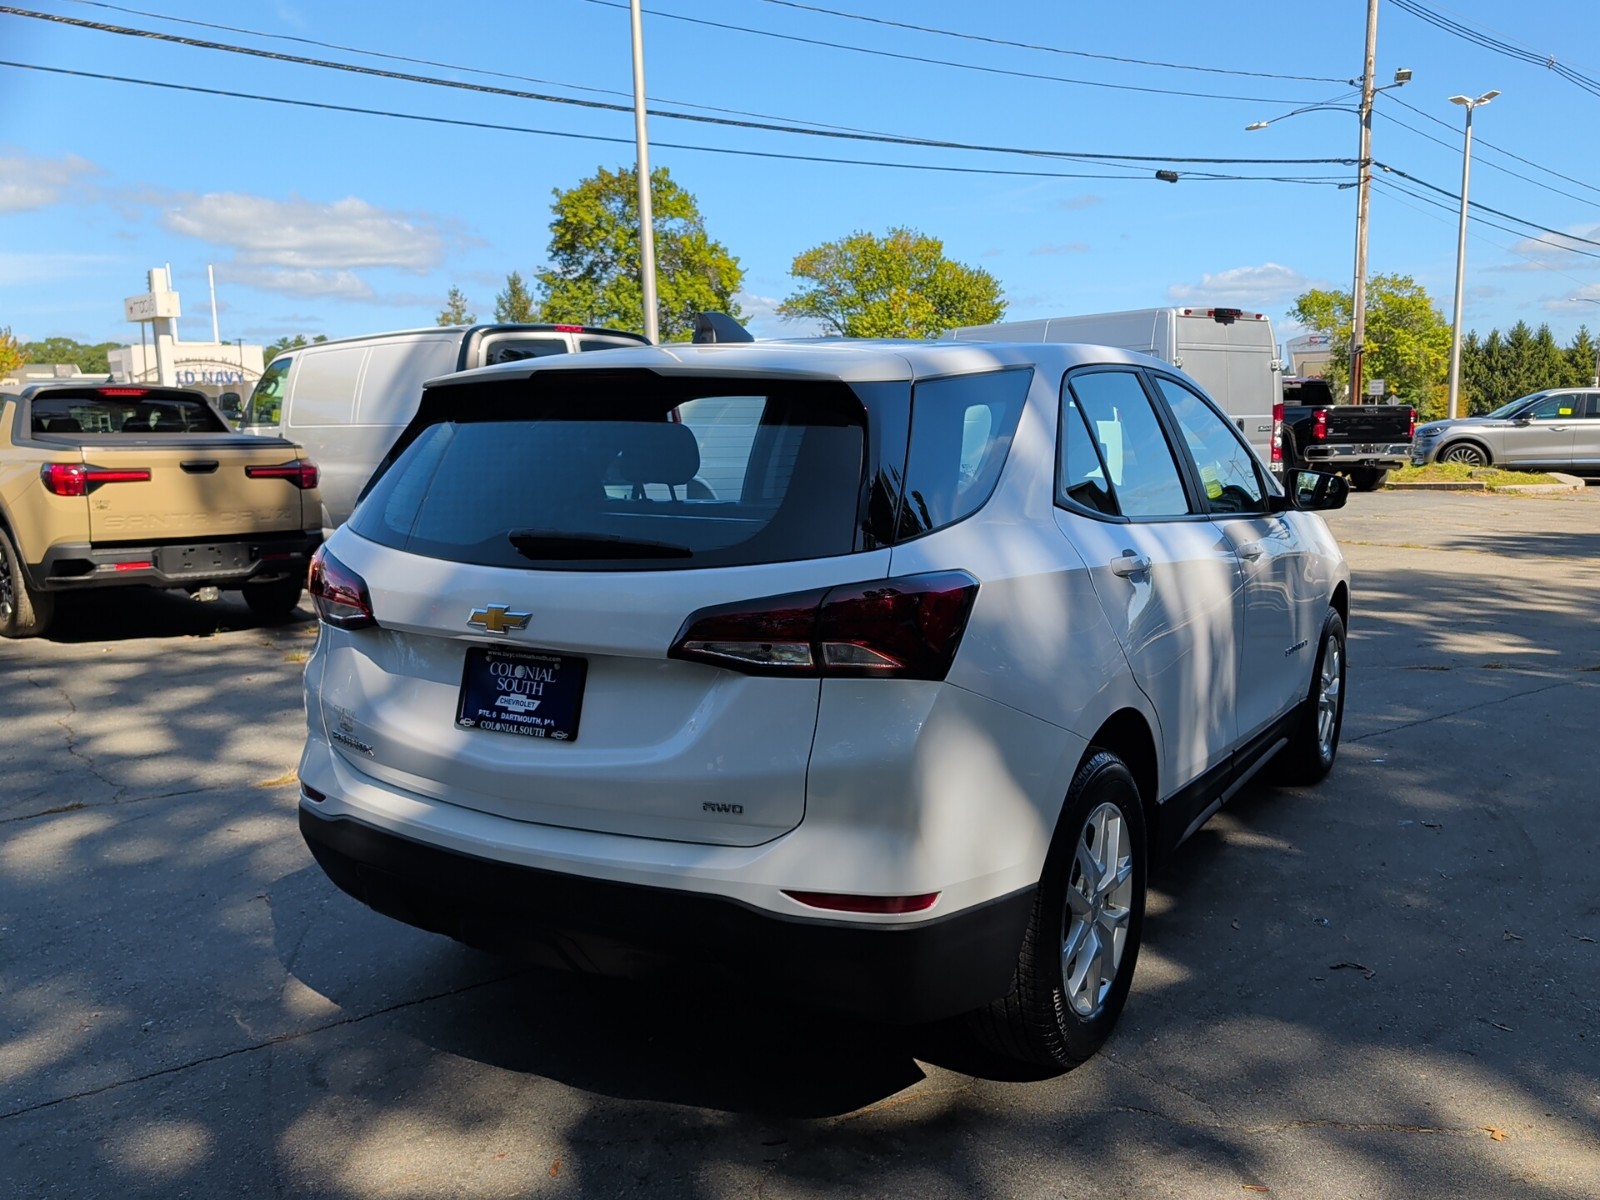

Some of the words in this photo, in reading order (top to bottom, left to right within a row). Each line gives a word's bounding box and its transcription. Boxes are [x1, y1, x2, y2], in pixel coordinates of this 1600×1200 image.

[176, 370, 196, 386] LD
[201, 370, 244, 385] NAVY
[104, 514, 210, 529] SANTA
[490, 662, 556, 682] COLONIAL
[496, 677, 544, 696] SOUTH
[500, 697, 535, 707] CHEVROLET
[480, 720, 518, 734] COLONIAL
[519, 725, 546, 737] SOUTH
